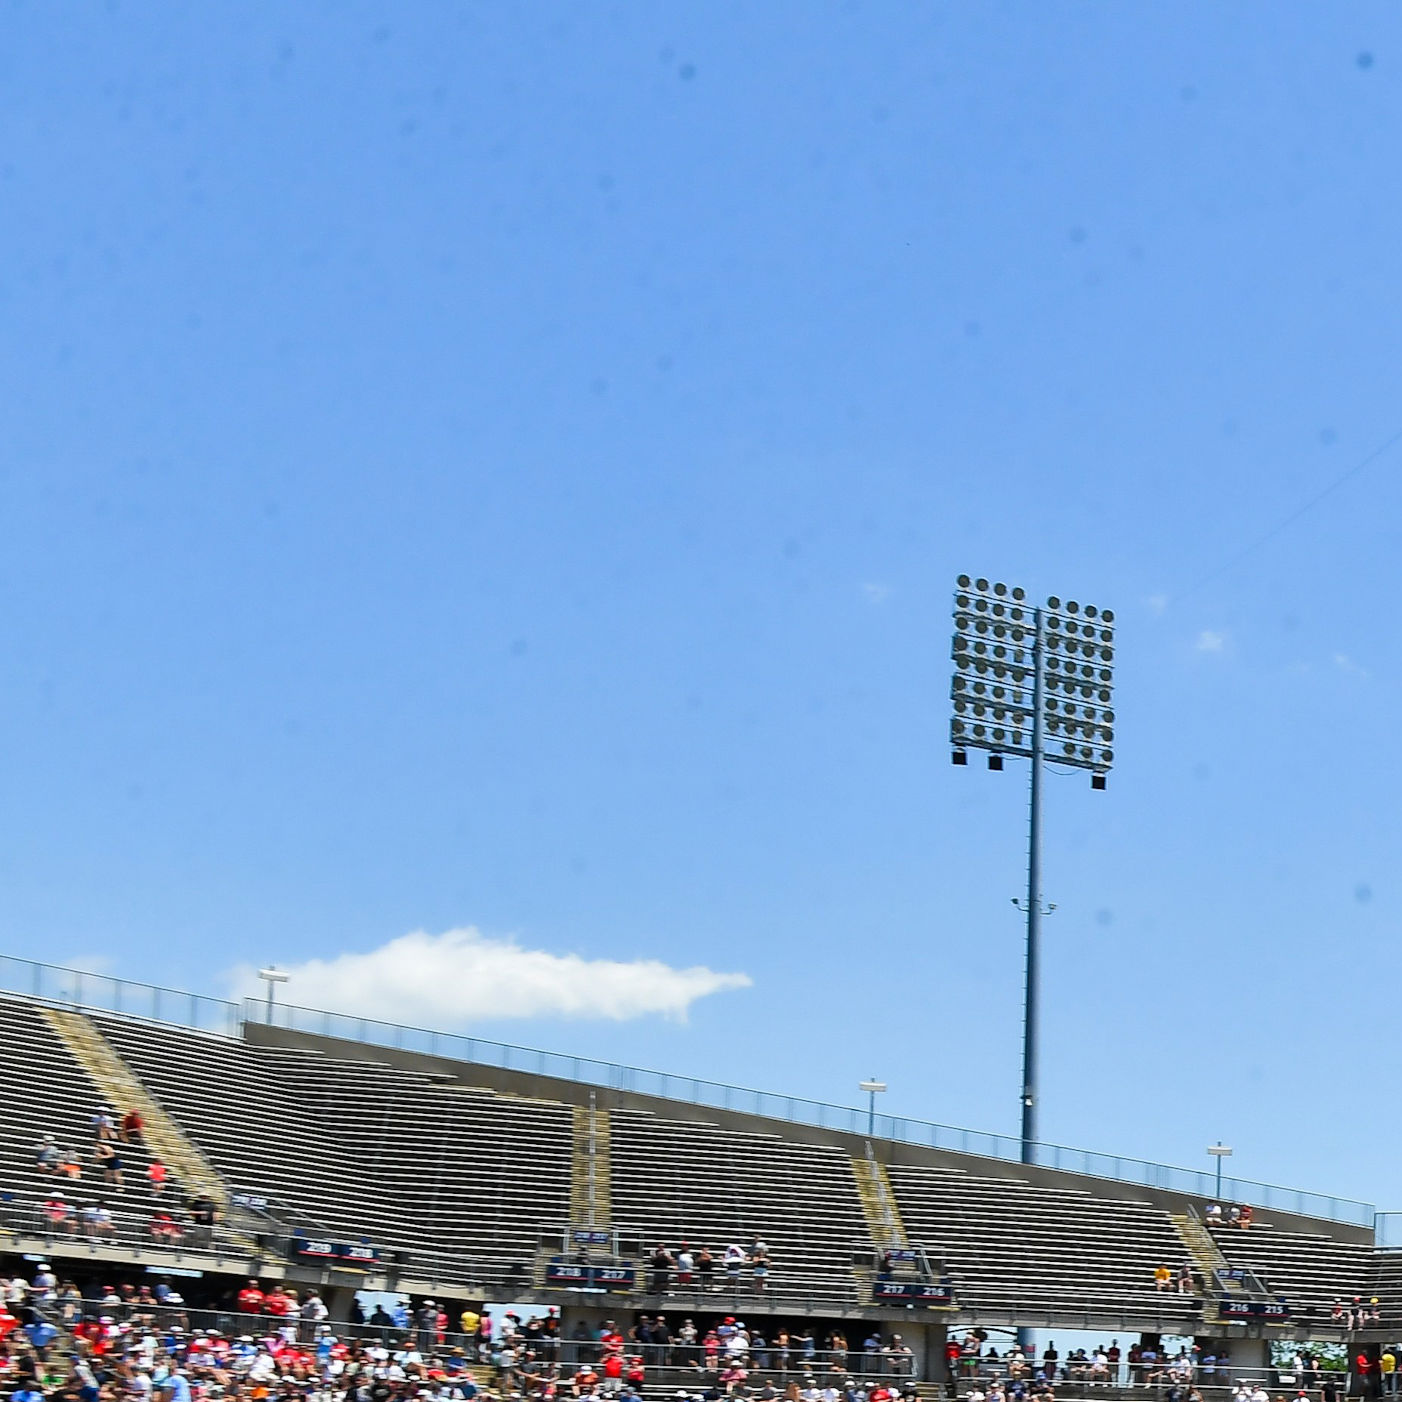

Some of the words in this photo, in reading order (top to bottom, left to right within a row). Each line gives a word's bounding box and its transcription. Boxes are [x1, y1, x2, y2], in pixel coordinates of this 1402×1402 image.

[601, 1269, 626, 1279] 217
[882, 1285, 905, 1294] 217
[1229, 1303, 1249, 1312] 216
[1264, 1305, 1284, 1314] 215
